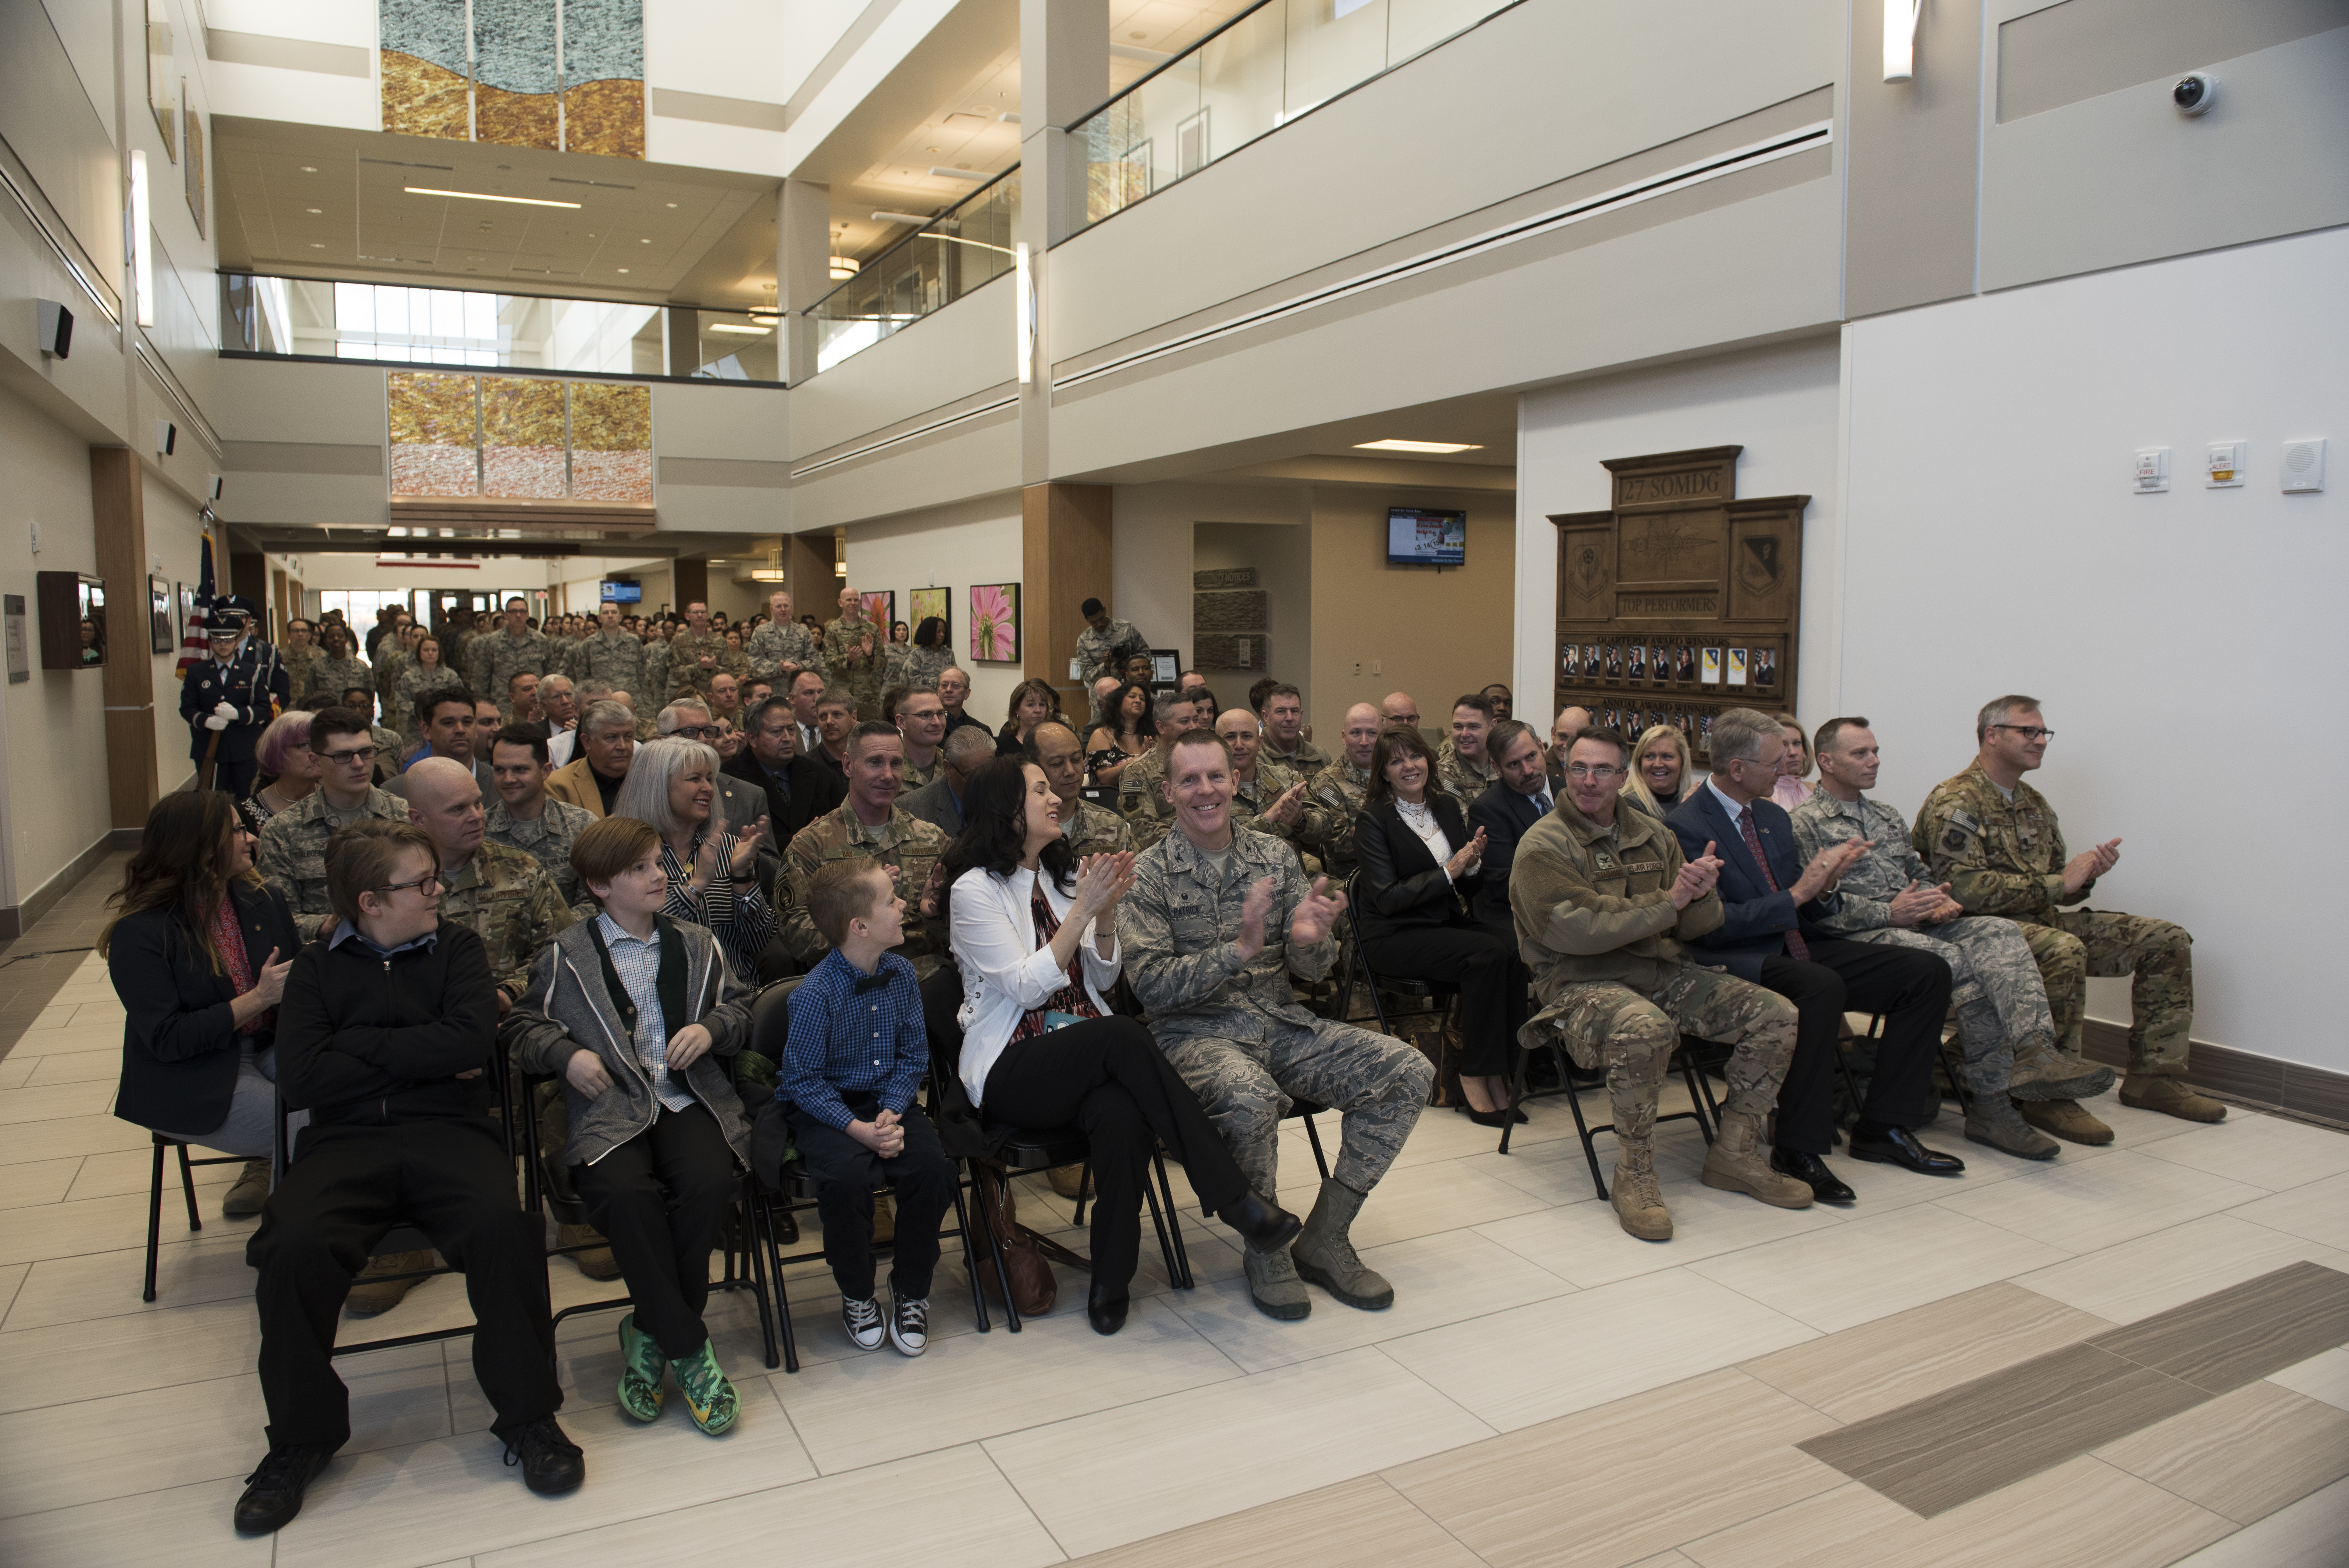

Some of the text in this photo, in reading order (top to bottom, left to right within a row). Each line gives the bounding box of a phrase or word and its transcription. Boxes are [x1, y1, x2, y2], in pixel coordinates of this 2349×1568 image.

[1624, 472, 1720, 500] 27 SOMDG
[1225, 572, 1251, 581] NOTICES
[1622, 597, 1717, 612] TOP PERFORMERS
[1597, 636, 1731, 646] QUARTERLY AWARD WINNERS
[1602, 698, 1722, 715] ANNUAL AWARD WINNERS
[1646, 862, 1663, 870] FORCE
[1595, 870, 1624, 879] HAMMONS
[491, 892, 502, 900] AIR
[504, 889, 526, 898] FORCE
[1173, 905, 1201, 916] PATRICK
